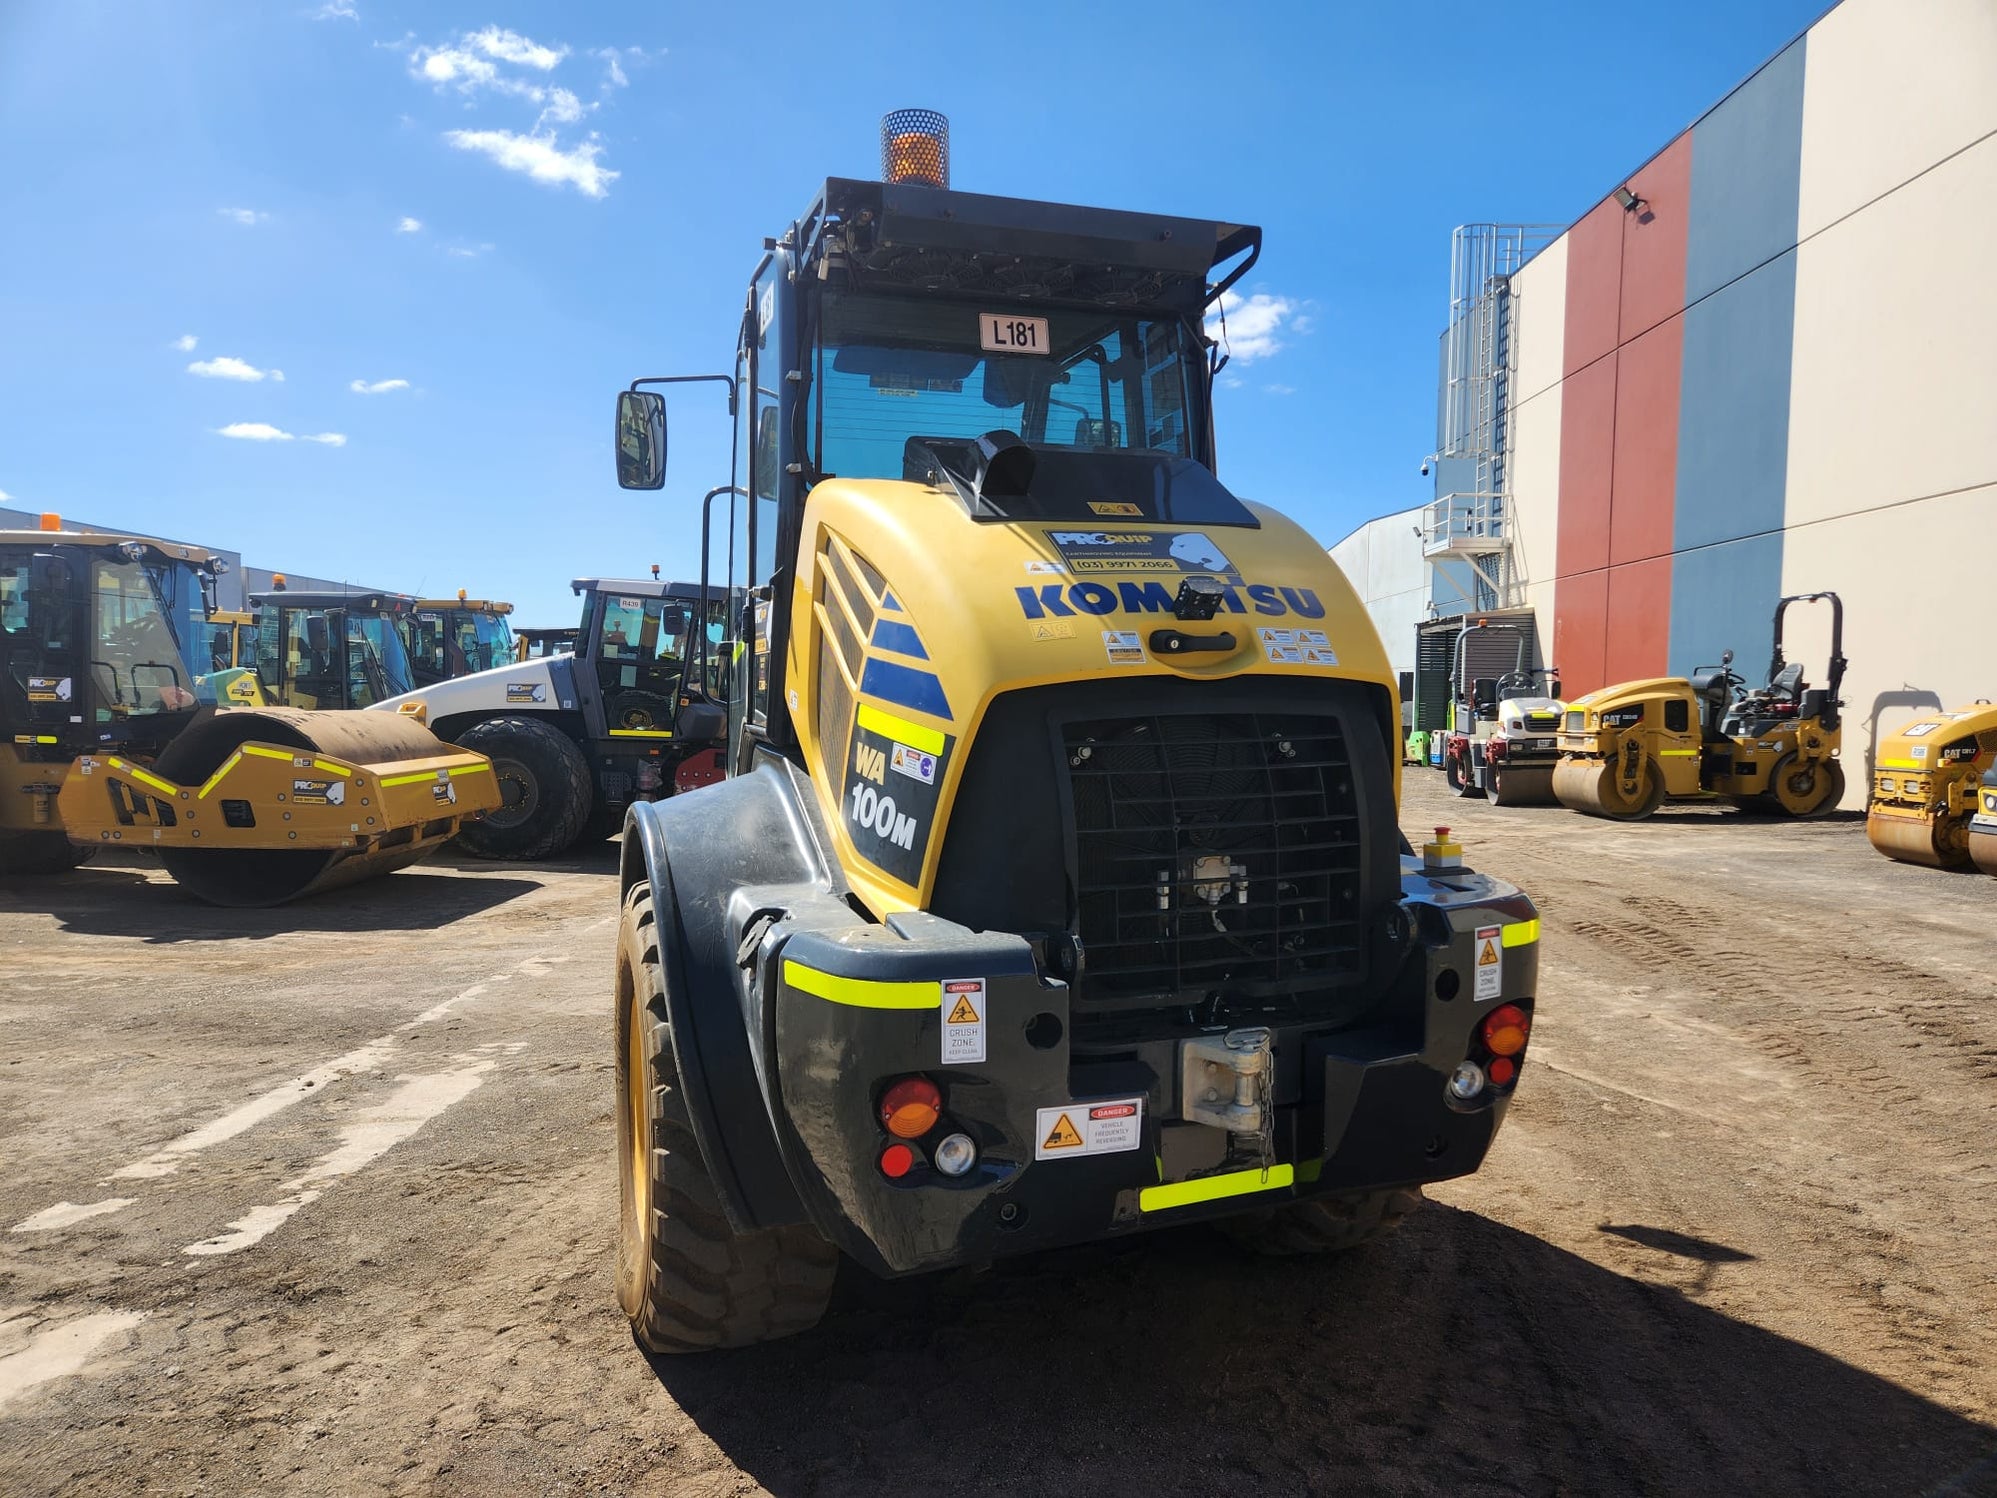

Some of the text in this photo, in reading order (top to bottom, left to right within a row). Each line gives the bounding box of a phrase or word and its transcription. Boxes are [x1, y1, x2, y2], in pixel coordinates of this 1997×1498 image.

[993, 320, 1036, 347] L181
[1076, 560, 1173, 570] (03) 9971 2066
[1014, 576, 1326, 619] KOMTSU
[1603, 714, 1621, 726] CAT
[1944, 748, 1961, 759] CAT
[855, 741, 886, 786] WA
[852, 782, 917, 851] 100M
[949, 1028, 978, 1037] CRUSH
[1097, 1107, 1128, 1117] DANGER
